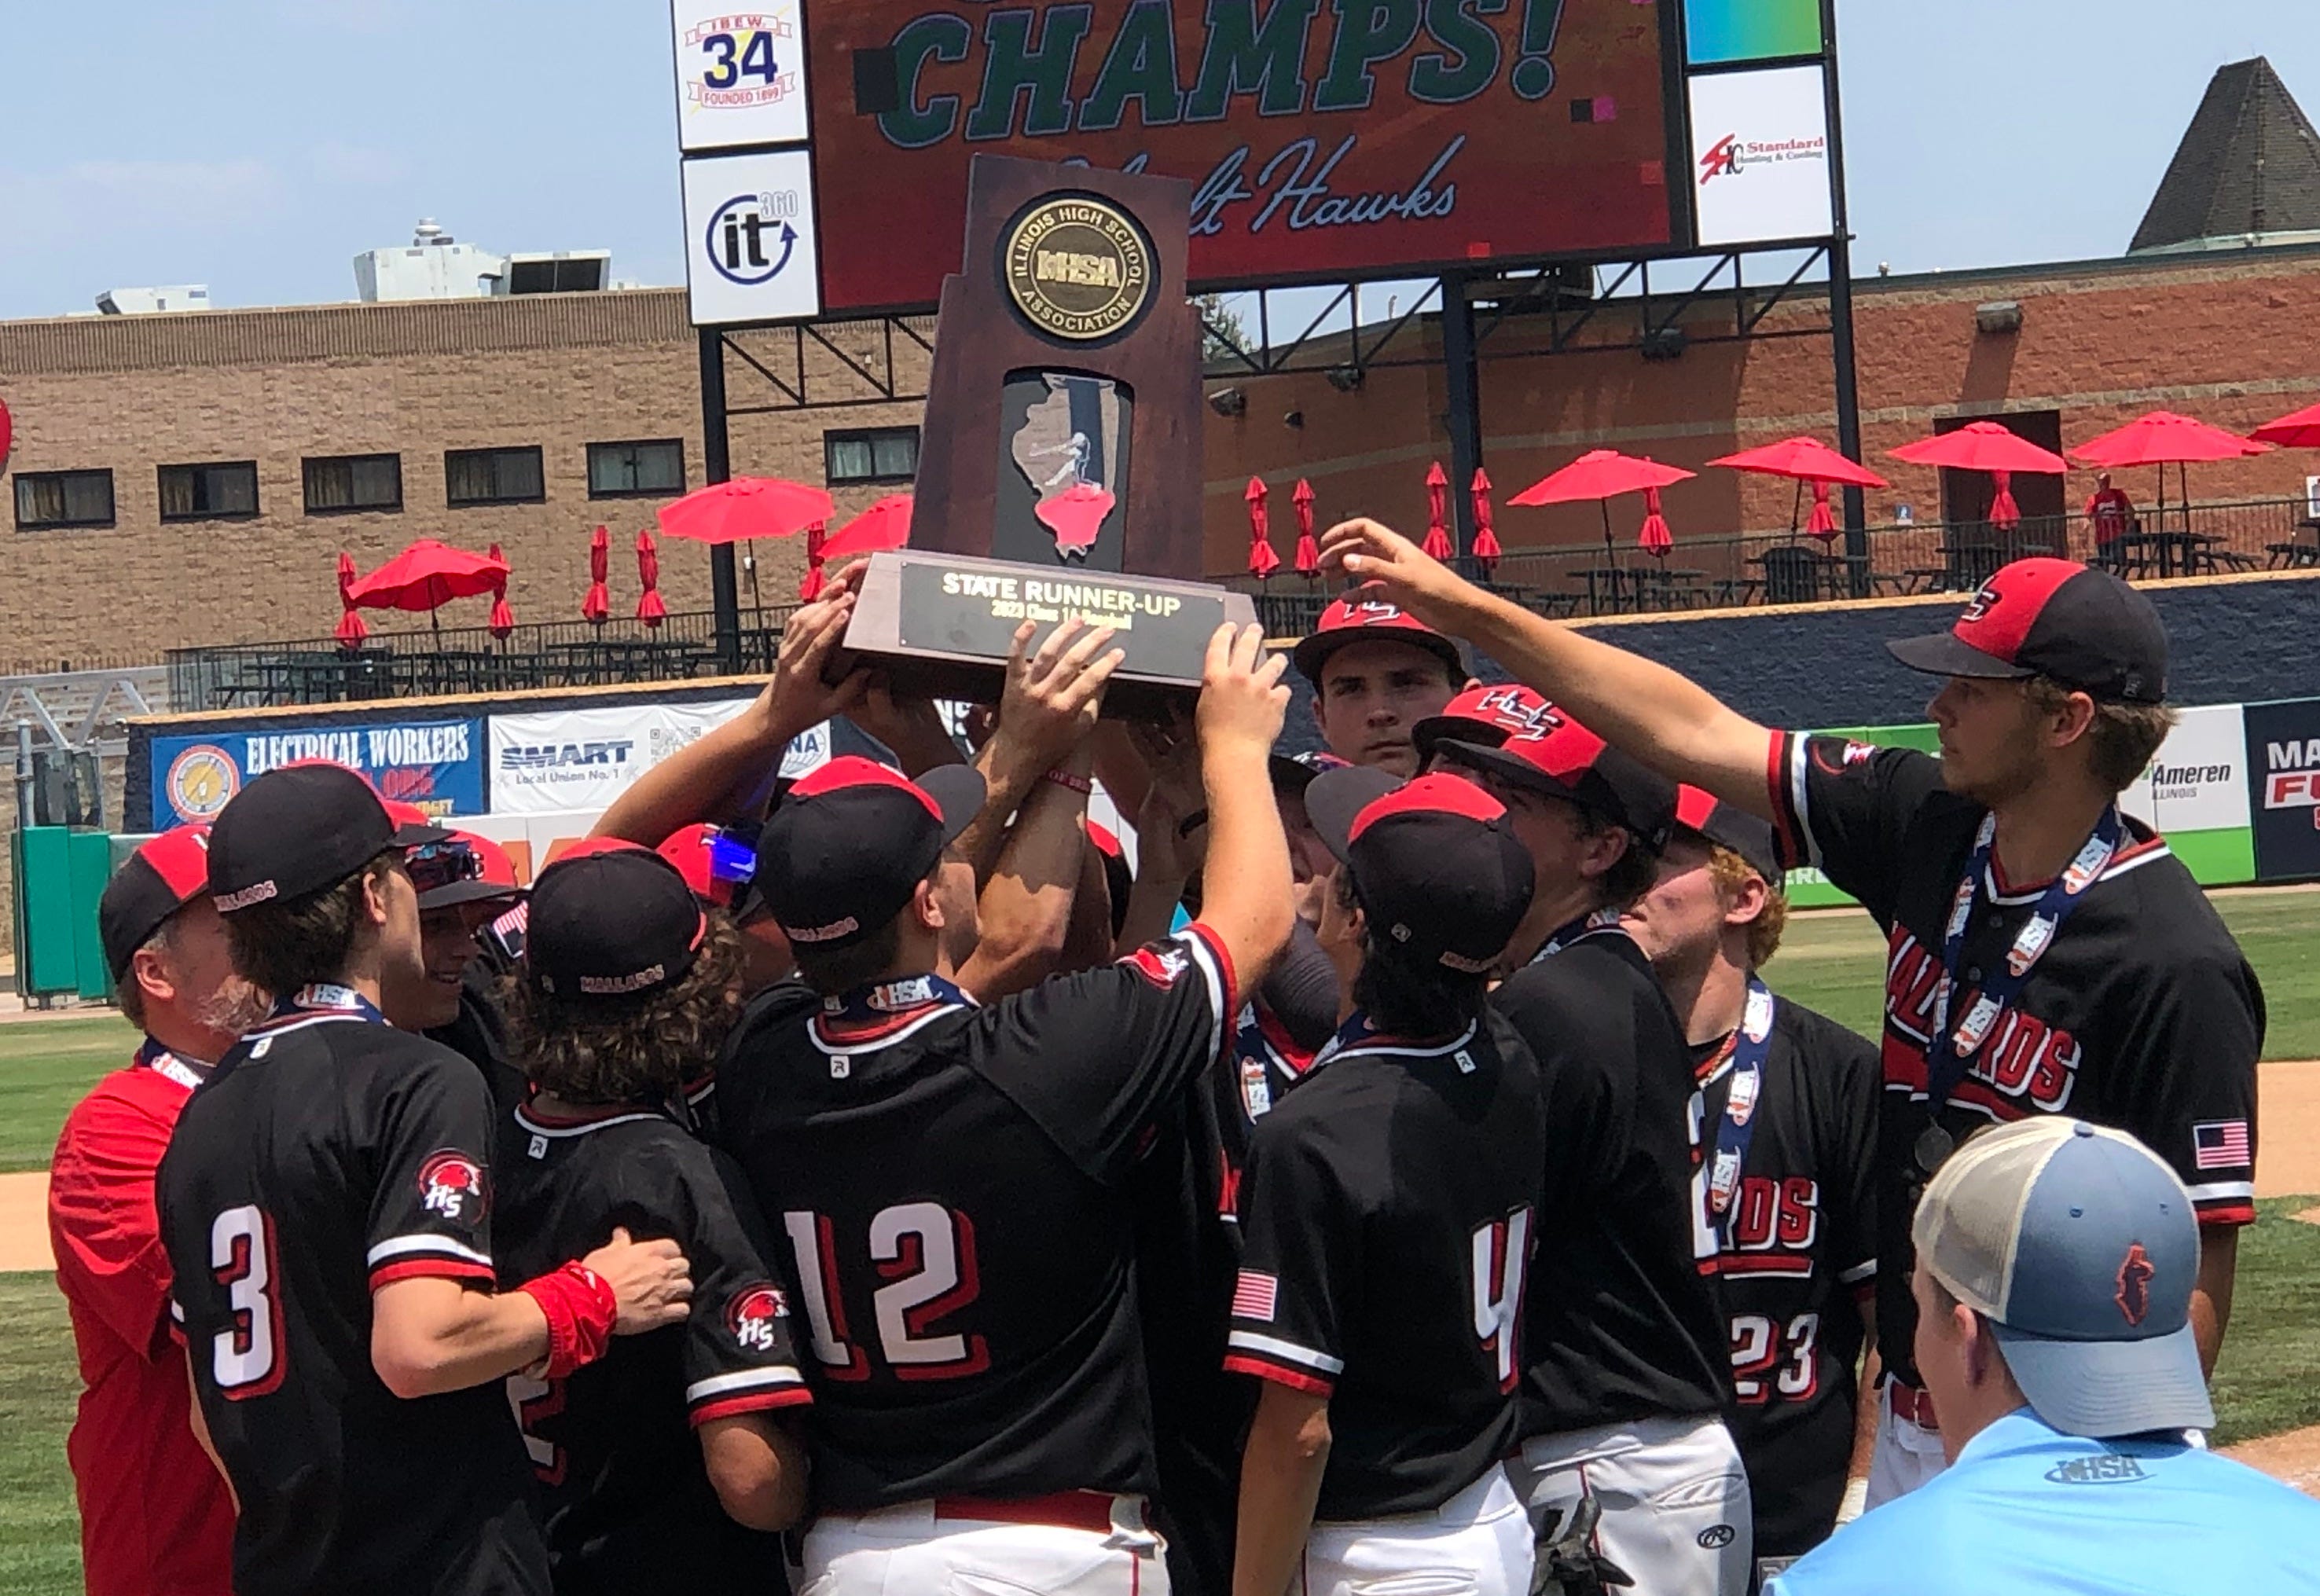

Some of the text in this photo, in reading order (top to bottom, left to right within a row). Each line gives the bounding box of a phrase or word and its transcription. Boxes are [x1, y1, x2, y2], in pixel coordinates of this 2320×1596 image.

[703, 31, 778, 89] 34
[875, 0, 1563, 149] CHAMPS!
[704, 92, 754, 105] FOUNDED
[1746, 136, 1824, 154] Standard
[760, 189, 798, 218] 360
[1251, 134, 1467, 233] Hawks
[724, 213, 781, 269] it
[1015, 207, 1142, 286] ILLINOIS HIGH SCHOOL
[1022, 290, 1132, 331] ASSOCIATION
[942, 572, 1181, 617] STATE RUNNER-UP
[246, 723, 470, 775] ELECTRICAL WORKERS
[500, 740, 633, 769] SMART
[2152, 764, 2230, 786] Ameren
[516, 772, 546, 784] Local
[550, 772, 586, 782] Union
[2153, 787, 2197, 800] ILLINOIS
[211, 1204, 285, 1401] 3
[783, 1202, 991, 1381] 12
[1471, 1202, 1533, 1396] 4
[1730, 1312, 1819, 1403] 23
